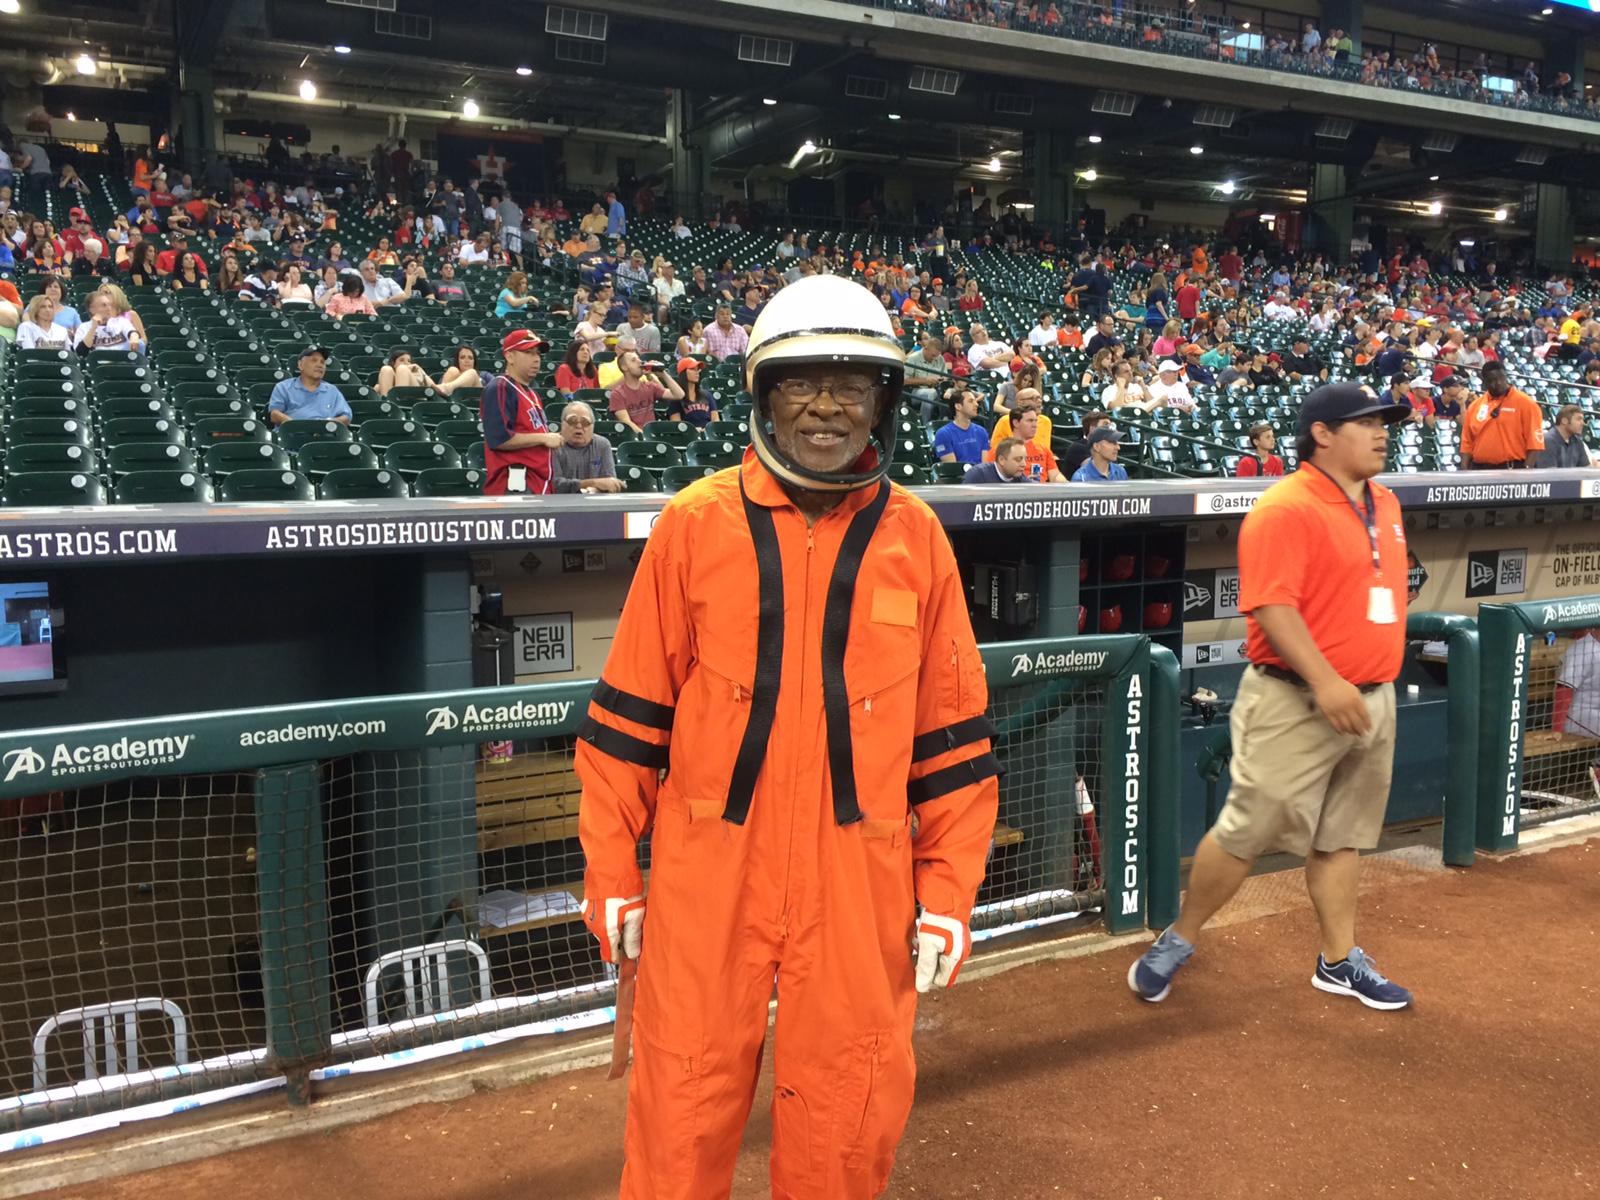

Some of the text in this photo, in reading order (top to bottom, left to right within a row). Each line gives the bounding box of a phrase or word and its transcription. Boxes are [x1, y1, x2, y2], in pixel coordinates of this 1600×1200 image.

[1427, 483, 1551, 502] ASTROSDEHOUSTON.COM
[972, 498, 1151, 522] ASTROSDEHOUSTON.COM
[0, 529, 178, 559] ASTROS.COM
[265, 518, 557, 550] ASTROSDEHOUSTON.COM
[1501, 558, 1523, 572] NEW
[1220, 578, 1240, 593] NE
[1501, 571, 1522, 585] ERA
[1555, 575, 1571, 588] CAP
[1572, 574, 1582, 587] OF
[1220, 593, 1239, 608] ER
[522, 625, 564, 644] NEW
[523, 643, 565, 662] ERA
[1035, 649, 1106, 669] Academy
[462, 700, 570, 725] Academy
[239, 717, 386, 747] academy.com
[462, 718, 558, 733] SPORTS+OUTDOORS
[1502, 633, 1526, 837] ASTROS.COM
[51, 734, 190, 767] Academy
[51, 755, 175, 777] SPORTS+OUTDOORS
[1122, 674, 1142, 915] ASTROS.COM
